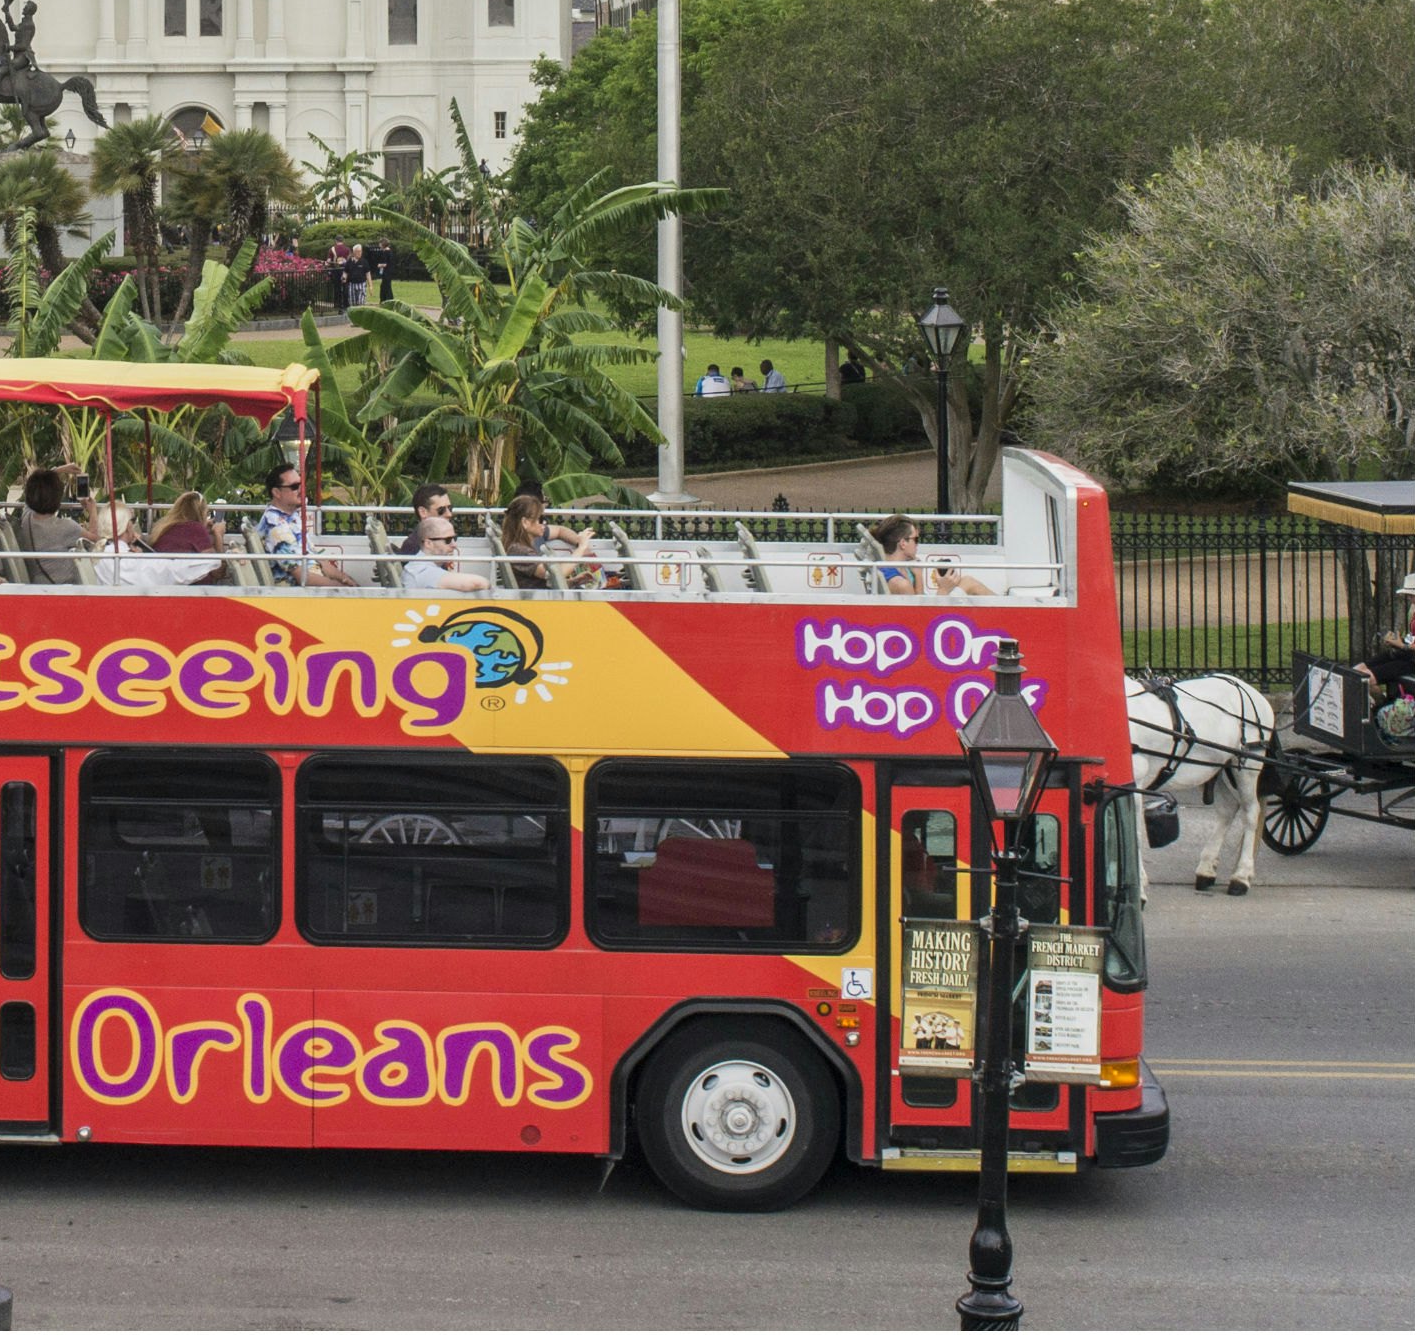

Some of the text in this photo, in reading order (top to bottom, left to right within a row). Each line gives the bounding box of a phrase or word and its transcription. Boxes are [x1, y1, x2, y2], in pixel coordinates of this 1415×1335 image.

[800, 621, 916, 674] Hop
[821, 682, 937, 735] Hop
[911, 930, 971, 952] MAKING
[1059, 932, 1073, 943] THE
[1031, 940, 1100, 957] FRENCH MARKET
[911, 950, 971, 971] HISTORY
[1046, 954, 1085, 967] DISTRICT
[910, 970, 970, 987] FRESH DAILY
[71, 987, 592, 1109] Orleans
